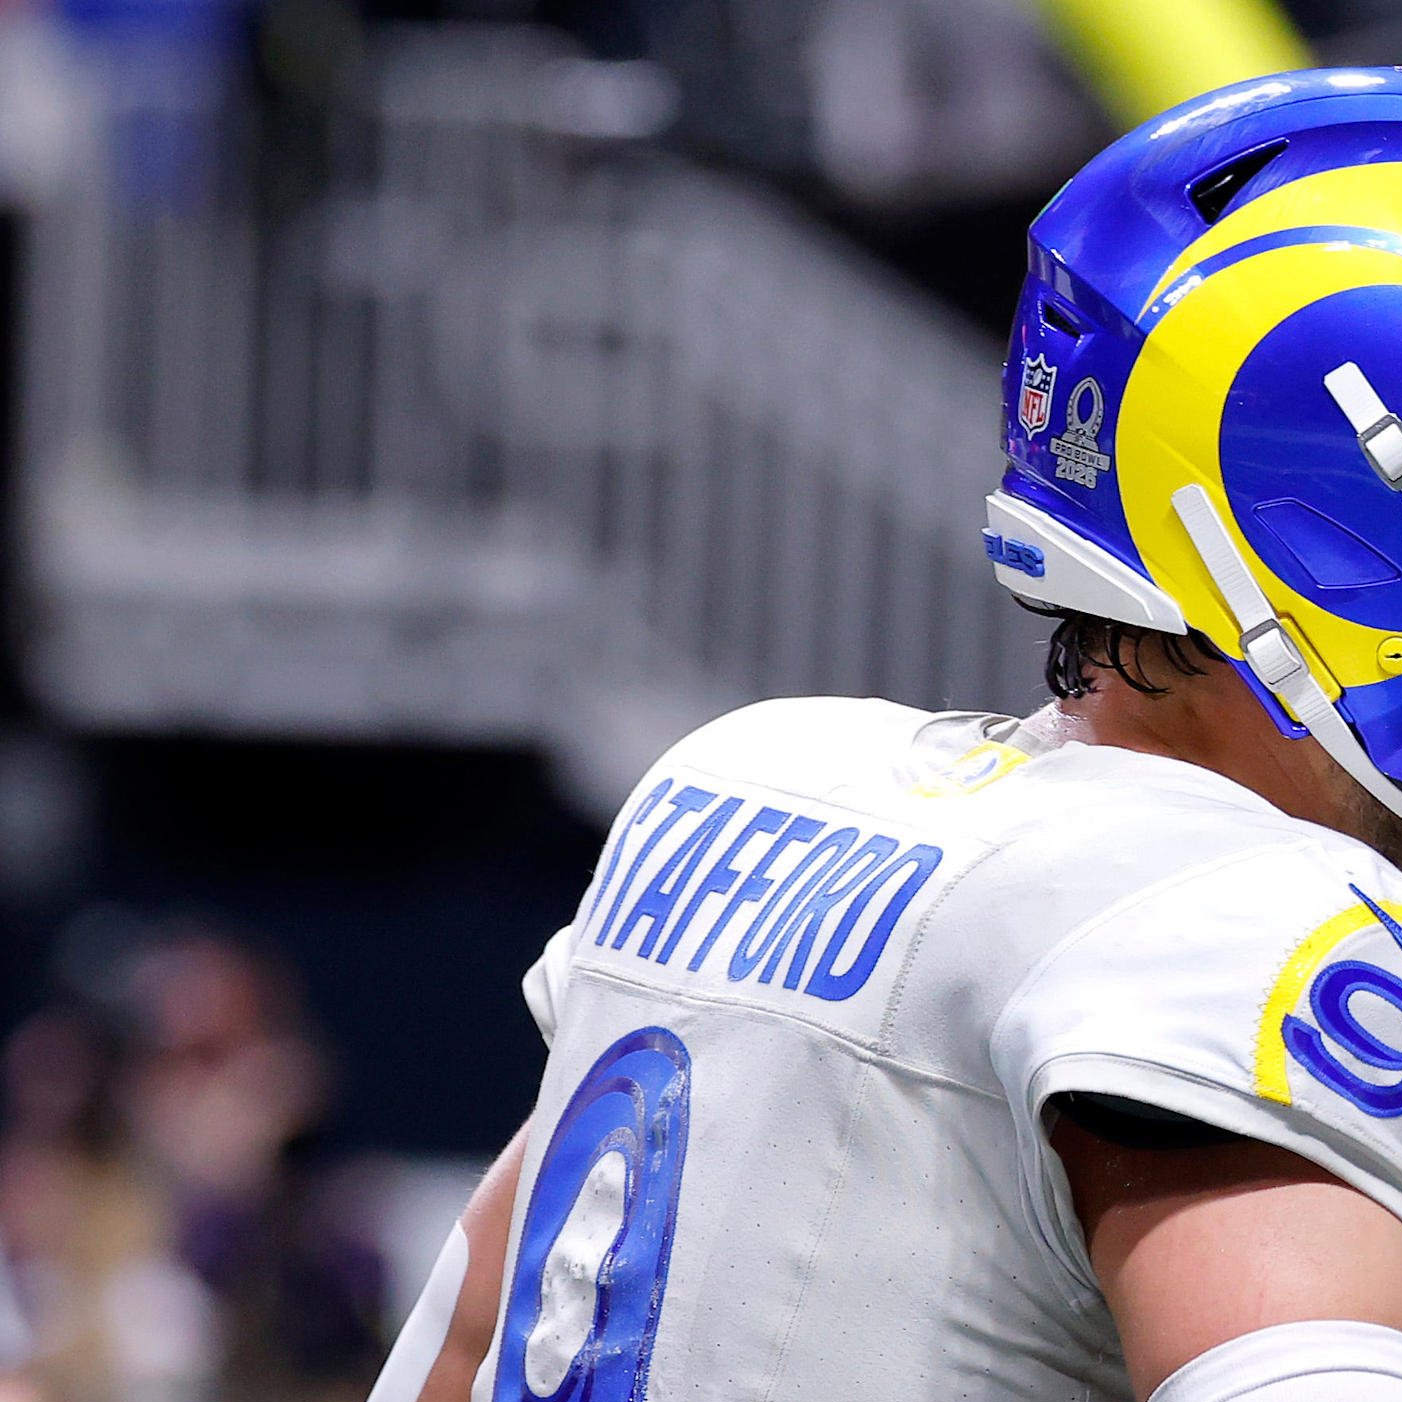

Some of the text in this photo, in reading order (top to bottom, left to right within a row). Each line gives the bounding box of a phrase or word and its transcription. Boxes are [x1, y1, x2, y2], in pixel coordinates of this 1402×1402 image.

[1022, 389, 1046, 424] NFL
[1055, 442, 1102, 467] PRO BOWL
[1055, 456, 1098, 490] 2026
[580, 777, 944, 1001] STAFFORD
